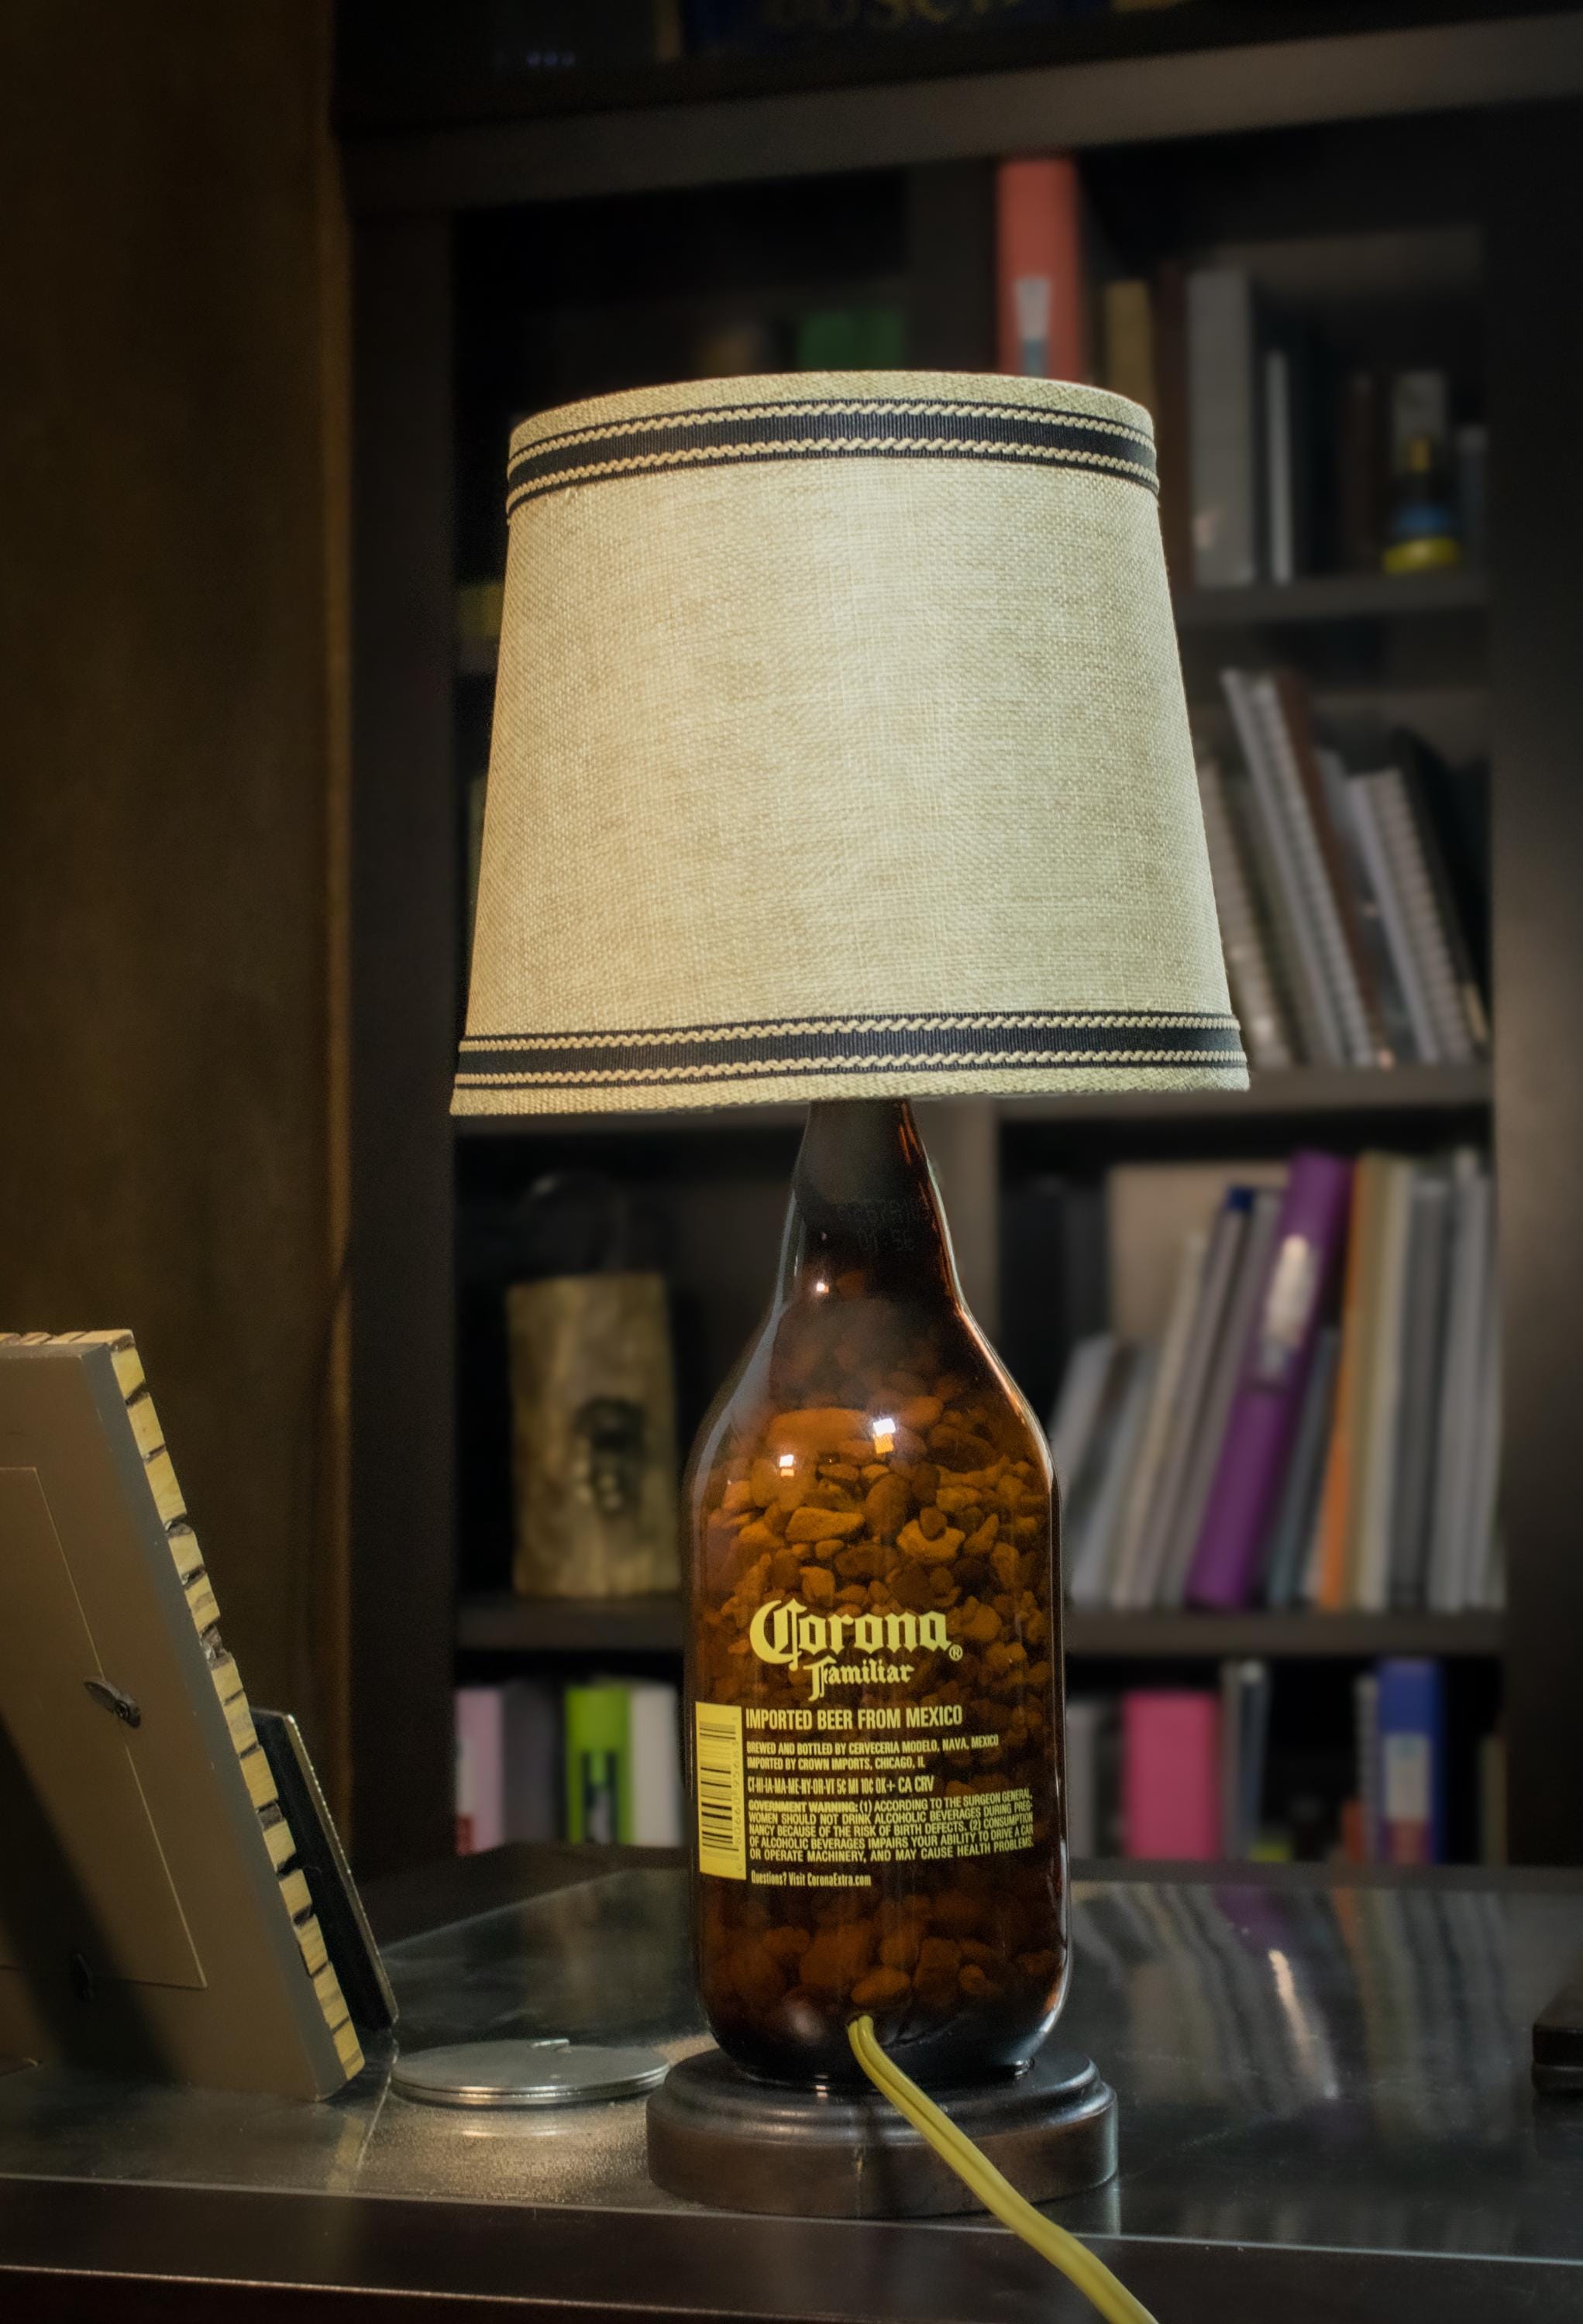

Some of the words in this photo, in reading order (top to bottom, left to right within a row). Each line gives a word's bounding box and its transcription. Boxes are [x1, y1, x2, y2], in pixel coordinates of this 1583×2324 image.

[803, 1655, 914, 1701] Familiar
[745, 1708, 813, 1730] IMPORTED
[817, 1709, 853, 1730] BEER
[857, 1708, 900, 1729] FROM
[906, 1705, 962, 1728] MEXICO
[746, 1741, 776, 1754] BREWED
[778, 1742, 795, 1755] AND
[797, 1742, 833, 1755] BOTTLED
[835, 1742, 847, 1755] BY
[848, 1741, 900, 1755] CERVECERIA
[901, 1739, 940, 1753] MODELO,
[971, 1734, 999, 1748] MEXICO
[747, 1756, 783, 1769] IMPORTED
[785, 1757, 797, 1770] BY
[798, 1758, 830, 1770] CROWN
[831, 1756, 872, 1771] IMPORTS,
[875, 1755, 915, 1769] CHICAGO,
[917, 1755, 926, 1769] IL
[848, 1778, 859, 1794] MI
[898, 1776, 913, 1793] CA
[914, 1774, 934, 1793] CRV
[748, 1800, 807, 1813] GOVERNMENT
[874, 1797, 928, 1813] ACCORDING
[930, 1796, 942, 1810] TO
[943, 1796, 962, 1809] THE
[962, 1792, 1000, 1807] SURGEON
[748, 1812, 778, 1824] WOMEN
[782, 1813, 817, 1825] SHOULD
[820, 1813, 839, 1825] NOT
[841, 1813, 872, 1825] DRINK
[874, 1810, 927, 1825] ALCOHOLIC
[930, 1806, 982, 1822] BEVERAGES
[983, 1803, 1012, 1817] DURING
[749, 1824, 775, 1836] NANCY
[777, 1825, 816, 1837] BECAUSE
[818, 1826, 831, 1837] OF
[833, 1825, 852, 1837] THE
[853, 1825, 876, 1837] RISK
[879, 1824, 892, 1837] OF
[893, 1823, 922, 1837] BIRTH
[924, 1820, 967, 1835] DEFECTS.
[969, 1818, 982, 1831] (2)
[983, 1811, 1034, 1830] CONSUMPTION
[749, 1836, 759, 1848] OF
[761, 1837, 809, 1850] ALCOHOLIC
[810, 1838, 865, 1850] BEVERAGES
[868, 1837, 908, 1850] IMPAIRS
[910, 1834, 938, 1848] YOUR
[940, 1831, 976, 1847] ABILITY
[978, 1829, 989, 1841] TO
[990, 1826, 1013, 1841] DRIVE
[1014, 1825, 1020, 1837] A
[1021, 1822, 1034, 1836] CAR
[750, 1848, 761, 1860] OR
[764, 1849, 804, 1862] OPERATE
[807, 1850, 866, 1864] MACHINERY,
[870, 1849, 892, 1863] AND
[895, 1848, 917, 1862] MAY
[921, 1844, 954, 1860] CAUSE
[956, 1841, 991, 1858] HEALTH
[993, 1835, 1034, 1854] PROBLEMS.
[751, 1869, 787, 1886] Questions?
[788, 1872, 806, 1886] Visit
[807, 1872, 872, 1887] CoronaExtra.com
